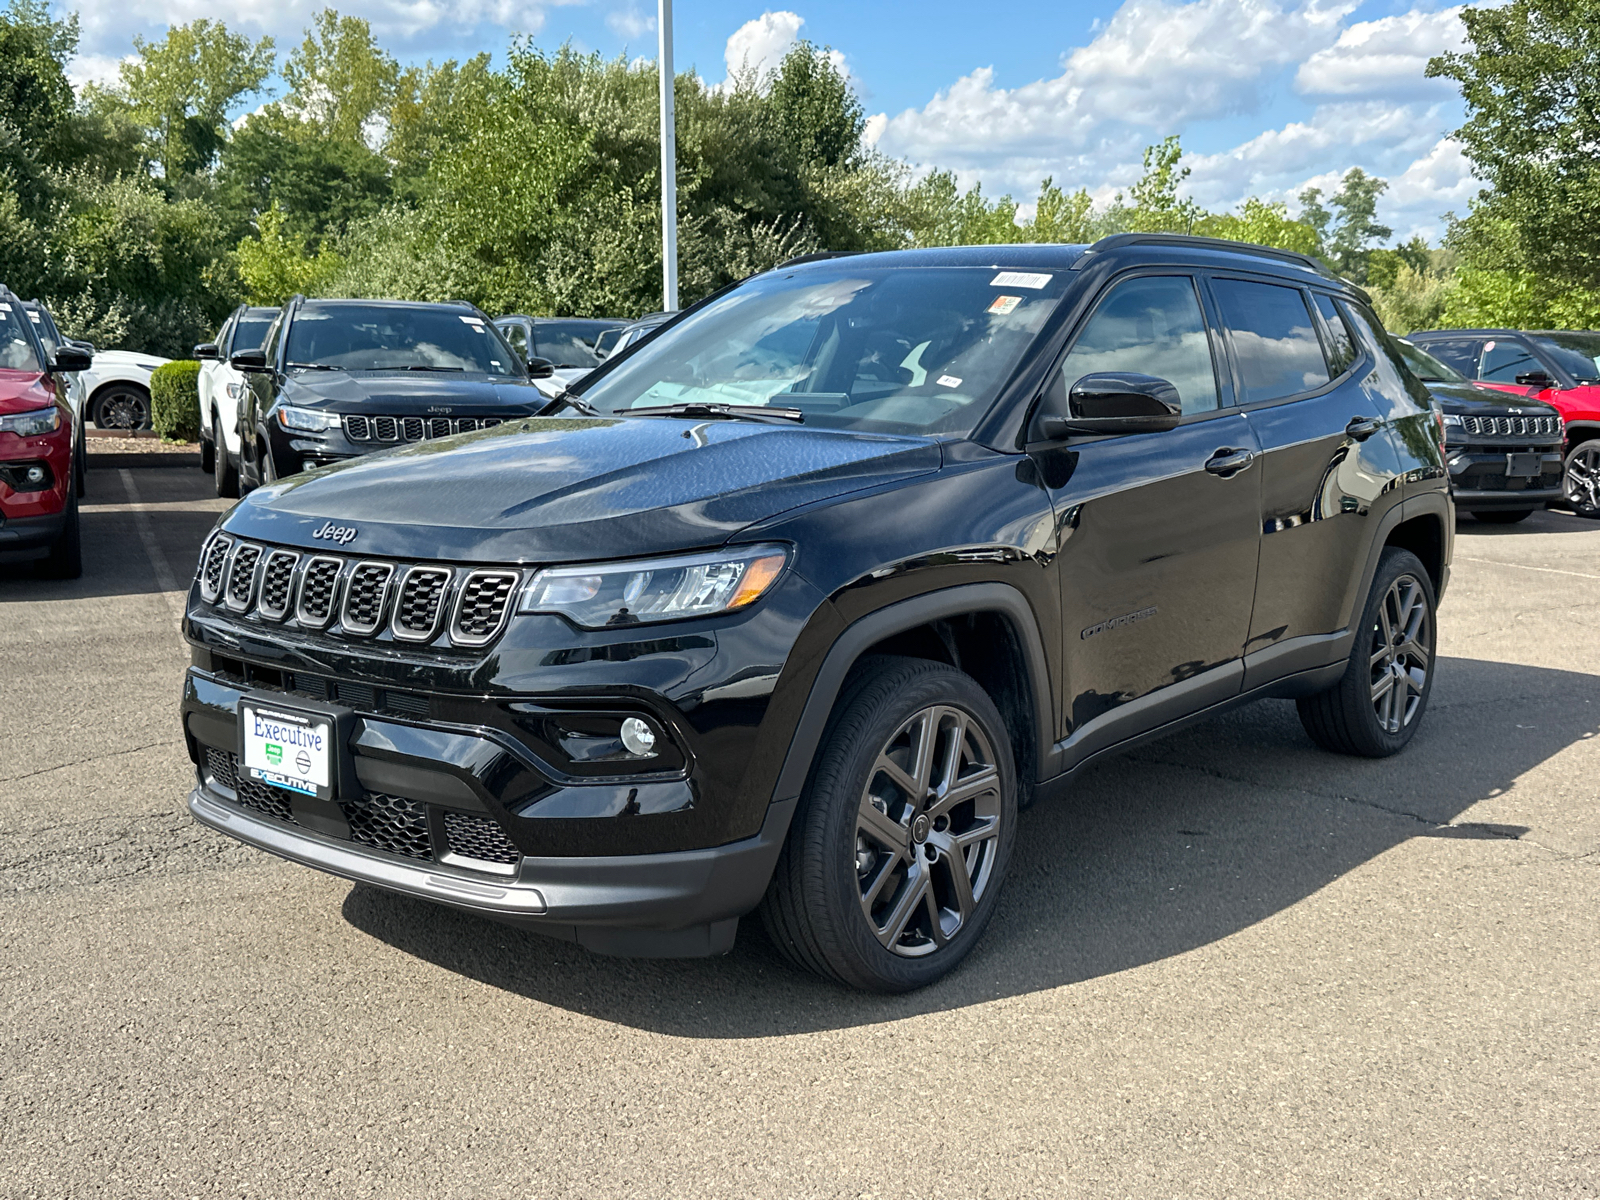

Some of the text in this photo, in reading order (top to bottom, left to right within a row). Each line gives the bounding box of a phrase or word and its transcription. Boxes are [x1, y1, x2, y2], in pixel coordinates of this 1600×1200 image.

[427, 405, 452, 414] Jeep
[312, 521, 357, 545] Jeep
[254, 714, 322, 752] Executive
[250, 768, 317, 793] EXECUTIVE
